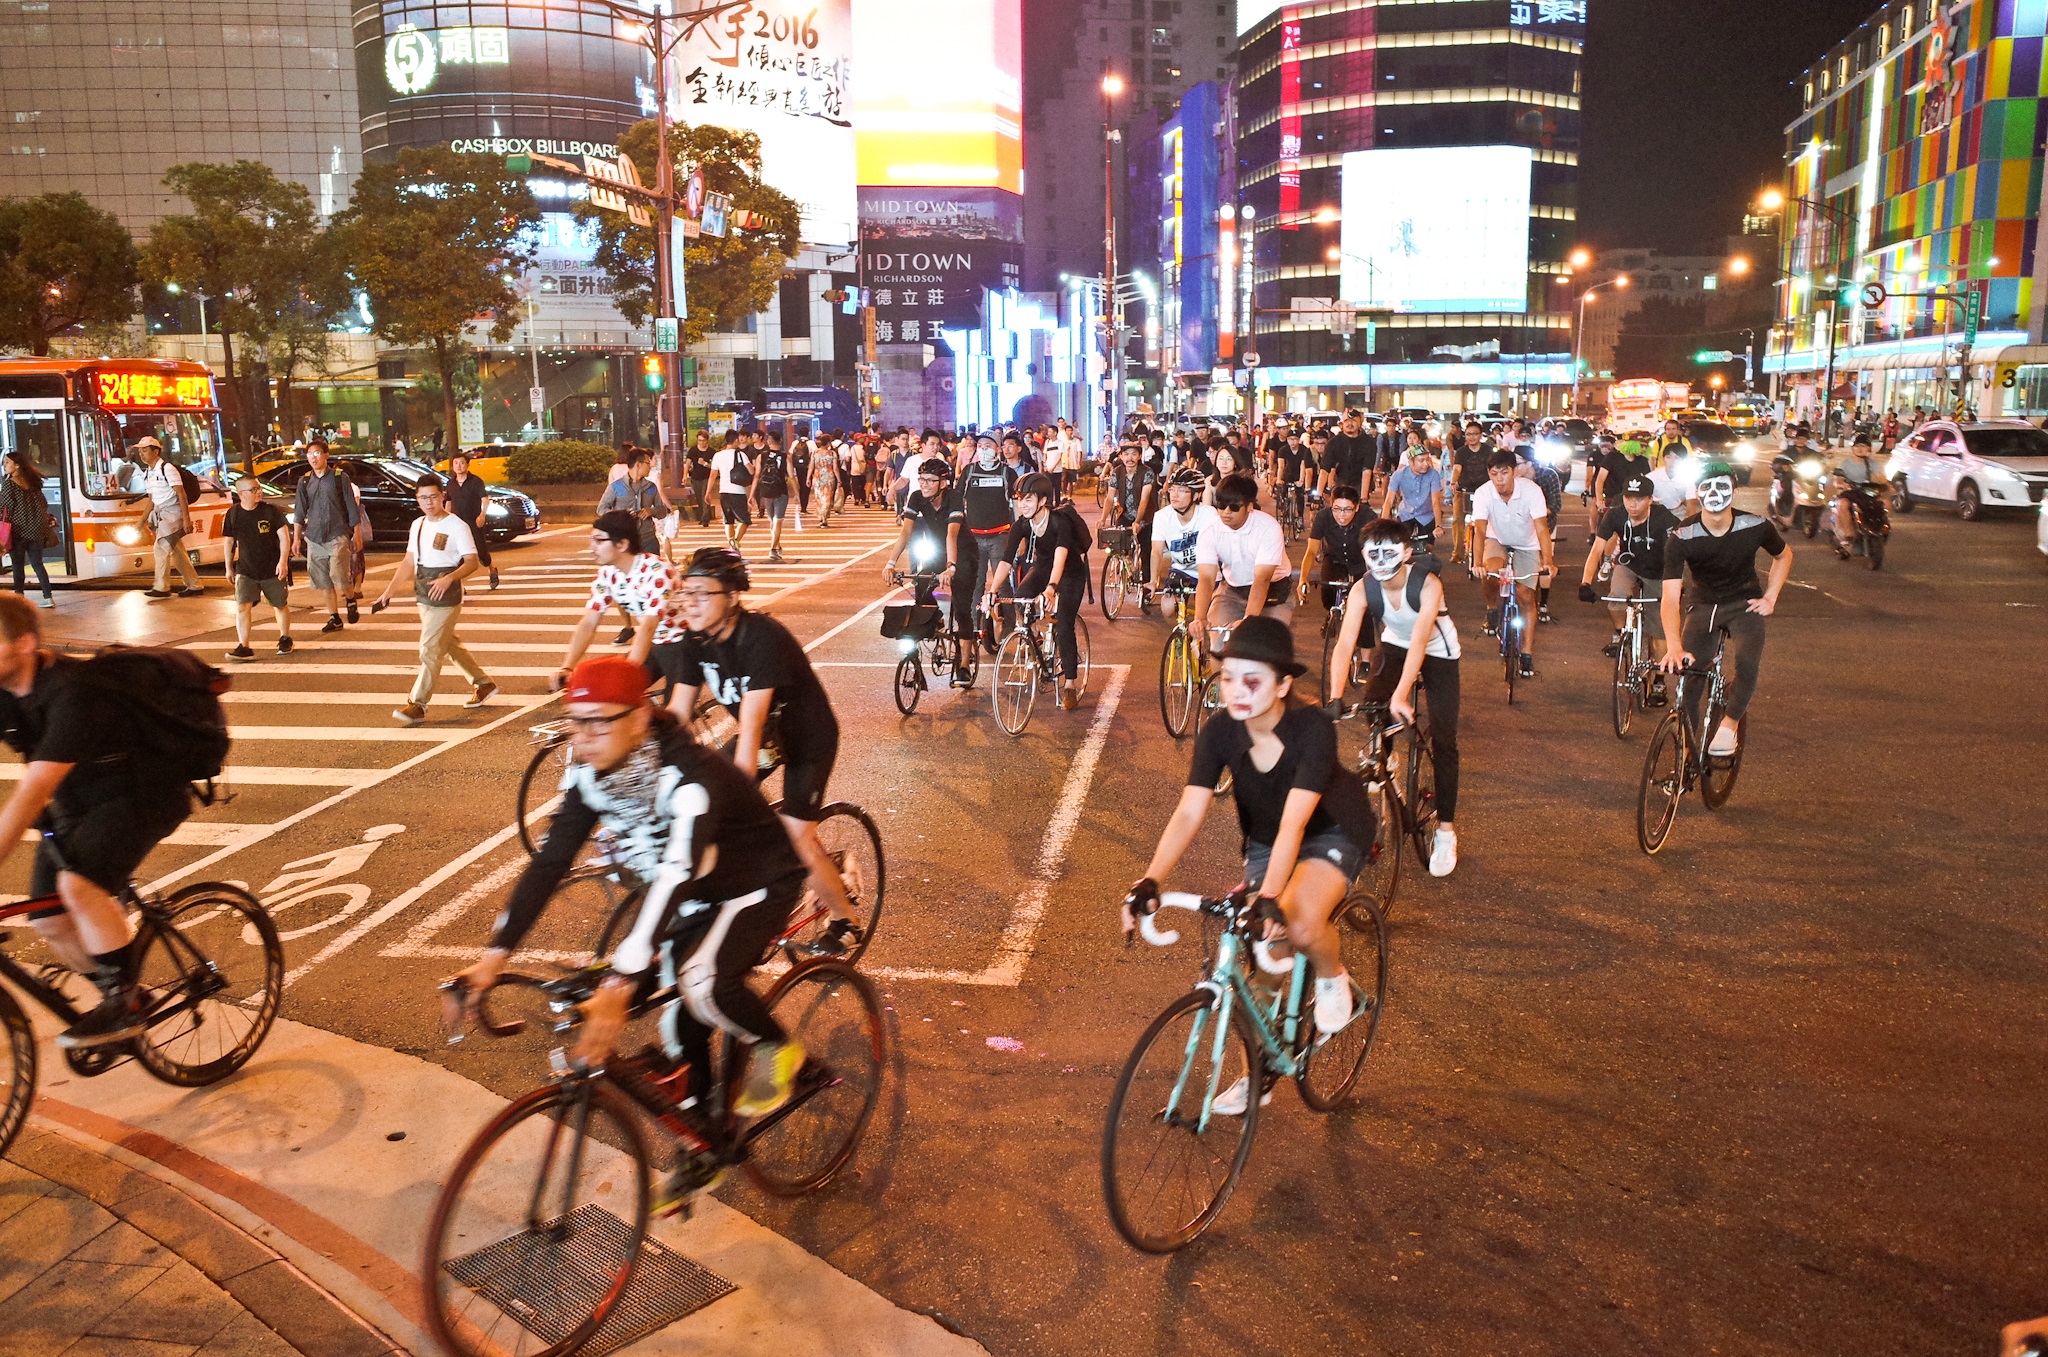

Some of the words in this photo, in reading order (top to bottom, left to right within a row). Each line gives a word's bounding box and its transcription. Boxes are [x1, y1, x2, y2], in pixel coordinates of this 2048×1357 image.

[754, 7, 819, 49] 2016
[398, 35, 419, 73] 5
[451, 138, 533, 155] CASHBOX
[865, 200, 958, 214] MIDTOWN
[877, 218, 928, 226] RICHARDSON
[874, 275, 943, 283] RICHARDSON
[875, 288, 944, 306] 德立莊
[876, 320, 945, 342] 海霸王
[1984, 370, 1991, 389] 3
[2002, 369, 2016, 388] 3
